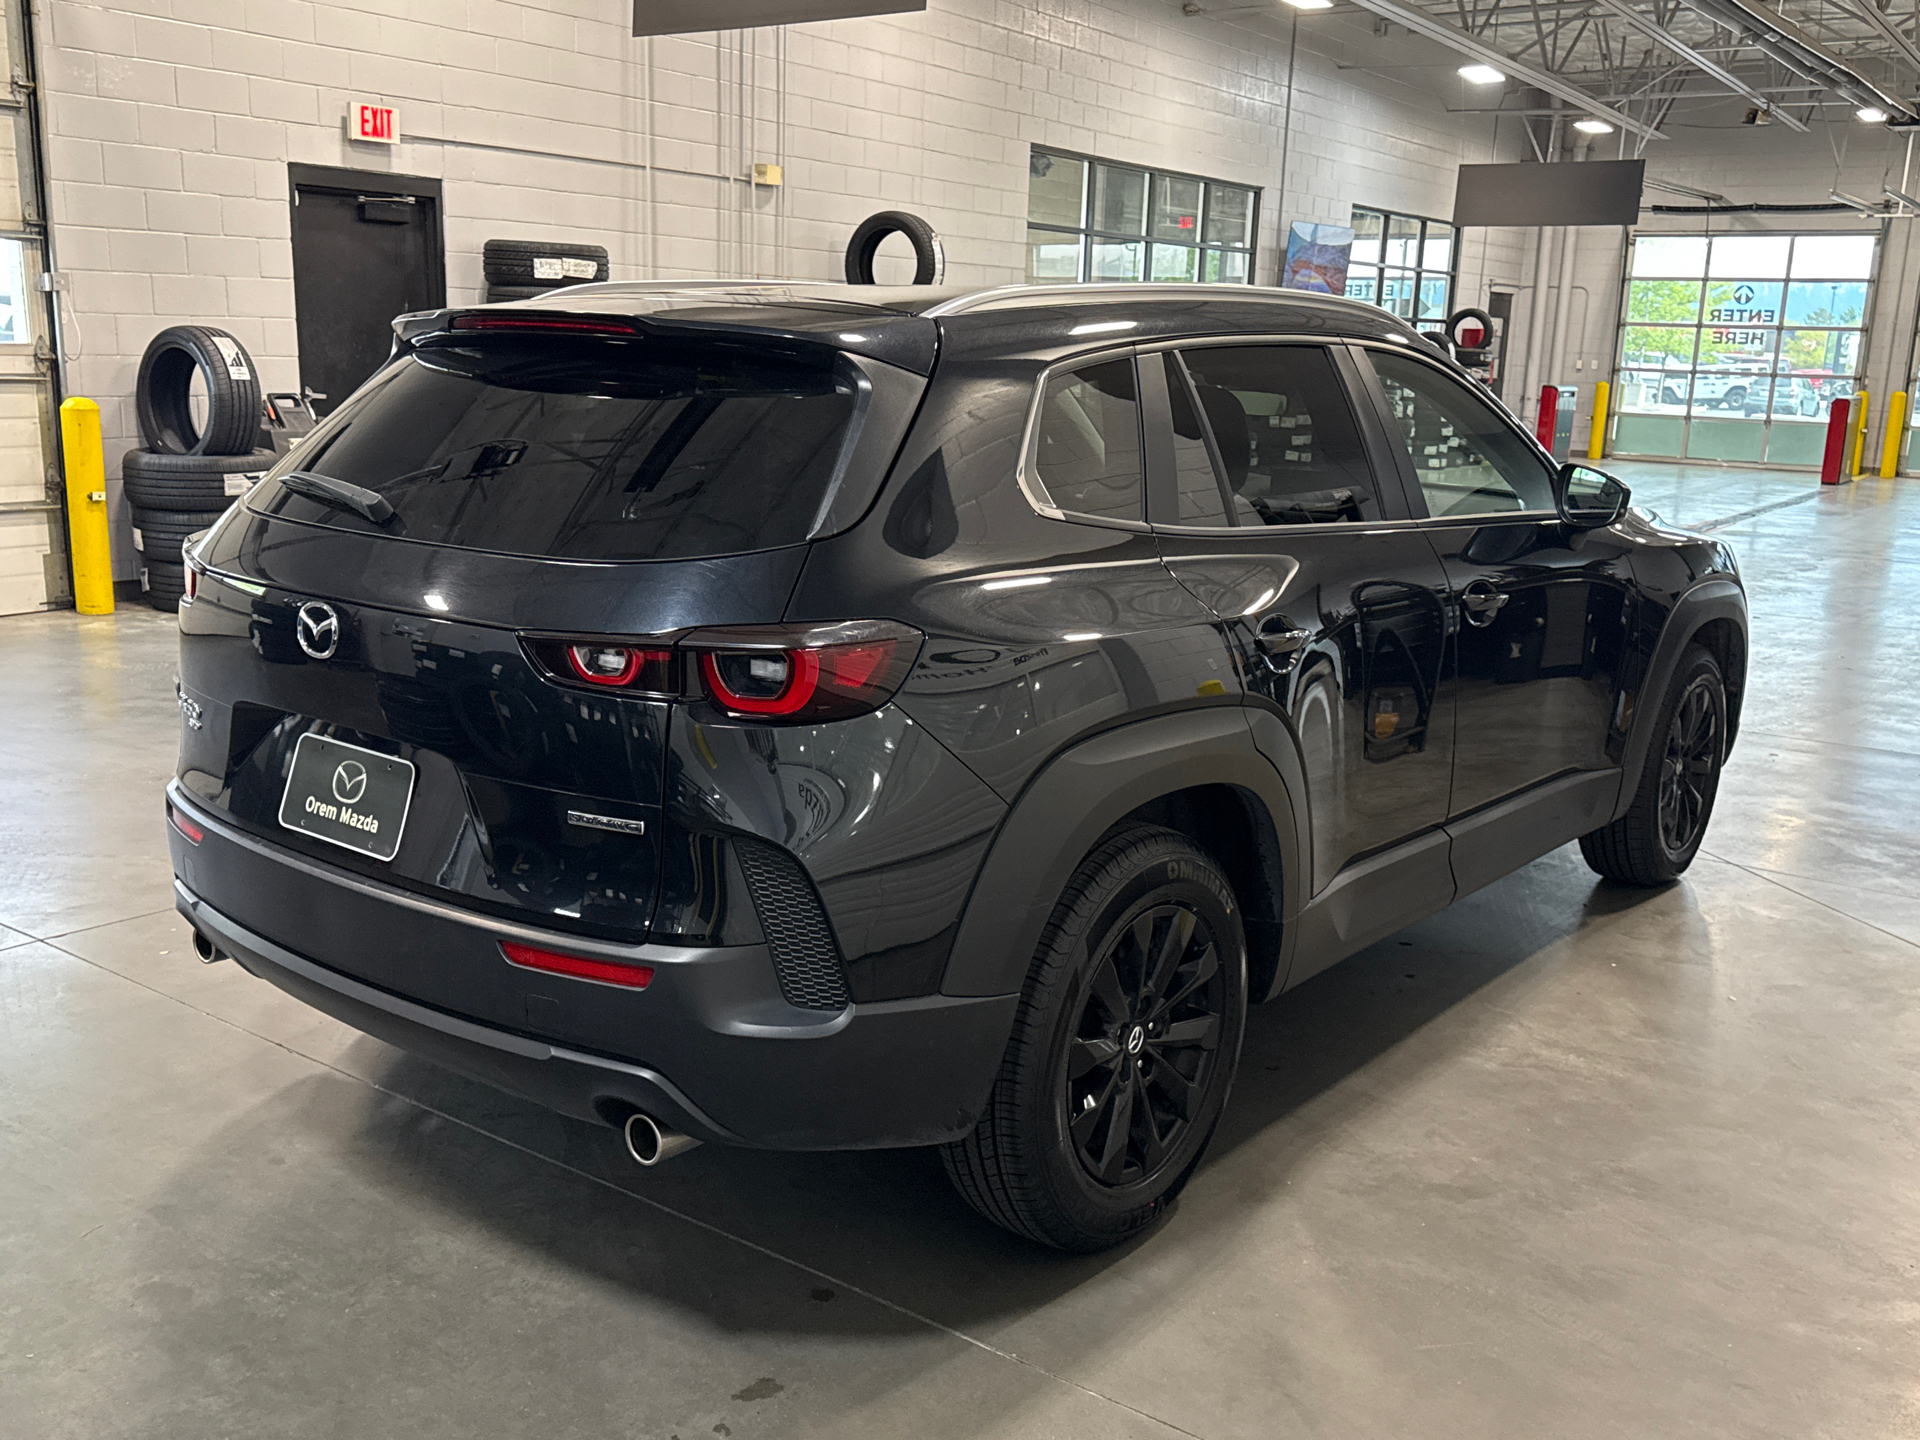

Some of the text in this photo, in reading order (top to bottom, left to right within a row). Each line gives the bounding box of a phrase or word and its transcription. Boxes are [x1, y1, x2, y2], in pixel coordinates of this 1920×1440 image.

[360, 105, 393, 140] EXIT
[305, 795, 379, 834] Orem Mazda
